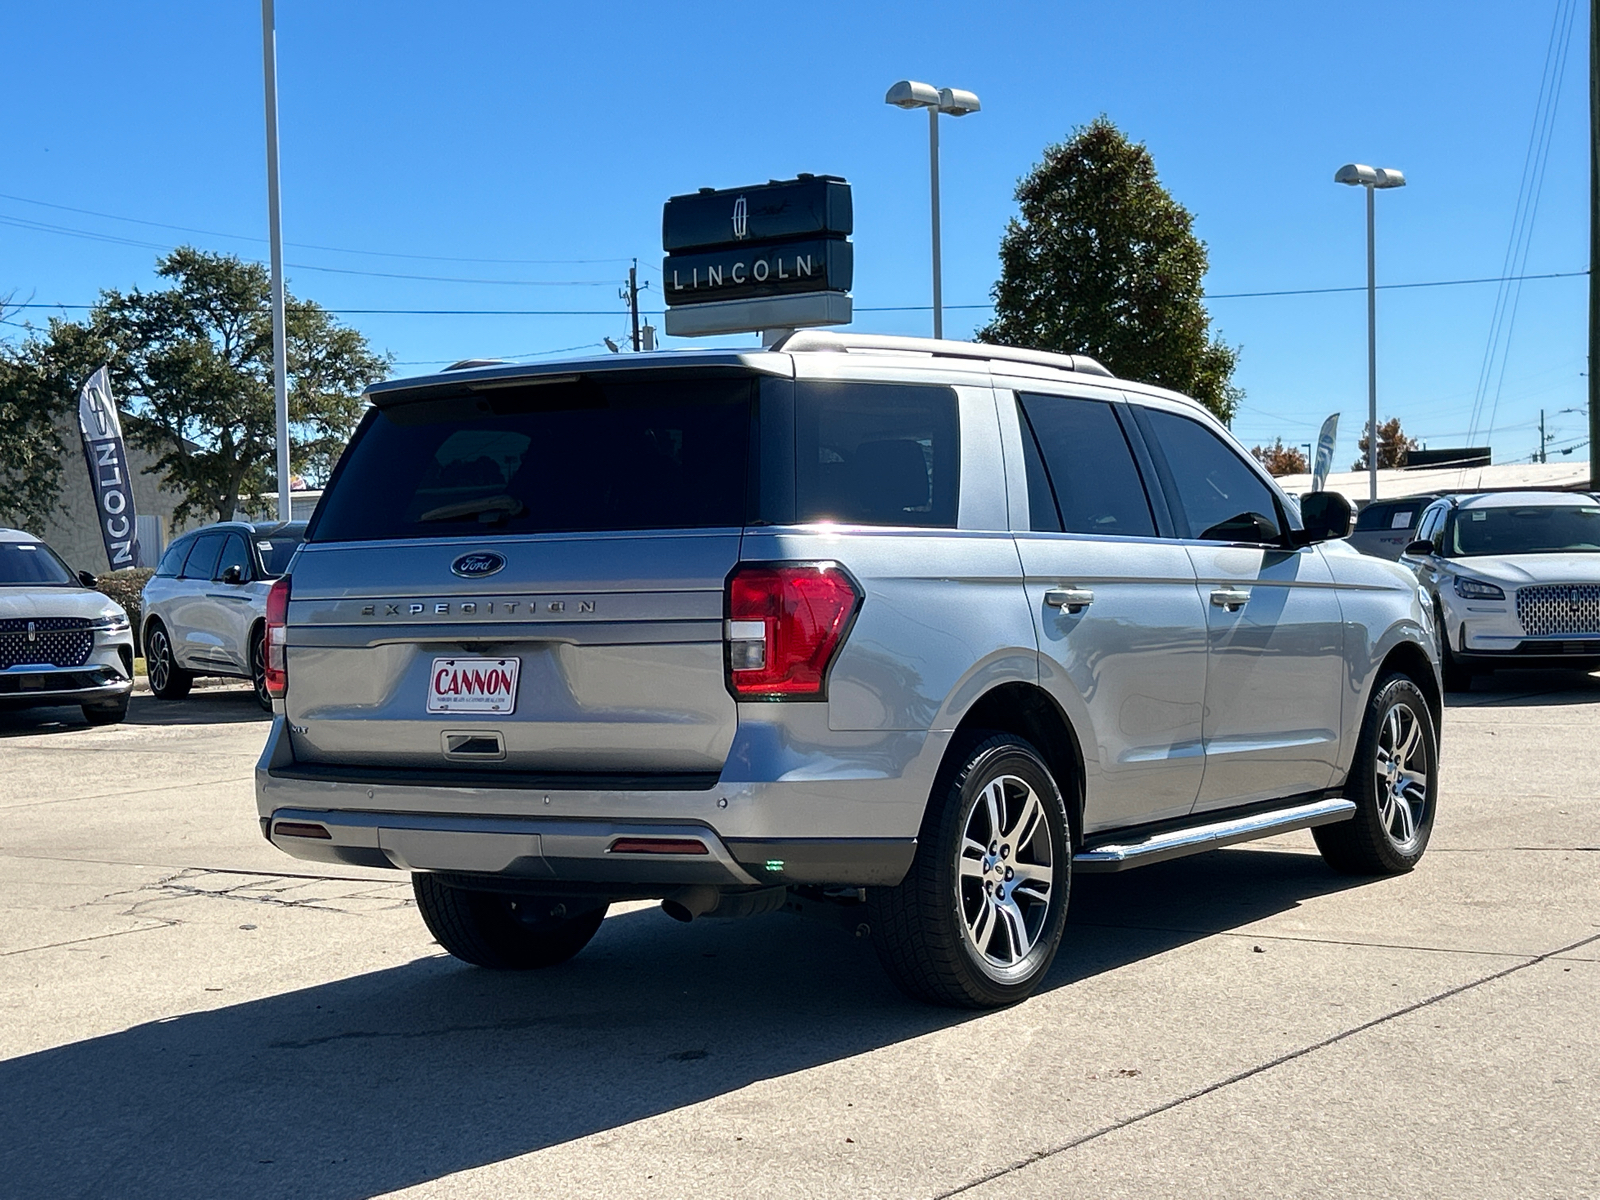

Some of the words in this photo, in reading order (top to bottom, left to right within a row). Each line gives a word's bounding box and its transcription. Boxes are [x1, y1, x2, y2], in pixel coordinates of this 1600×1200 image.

[673, 254, 812, 290] LINCOLN
[96, 442, 135, 572] NCOLN
[460, 555, 492, 571] Ford
[361, 601, 596, 616] EXPEDITION
[434, 668, 513, 695] CANNON
